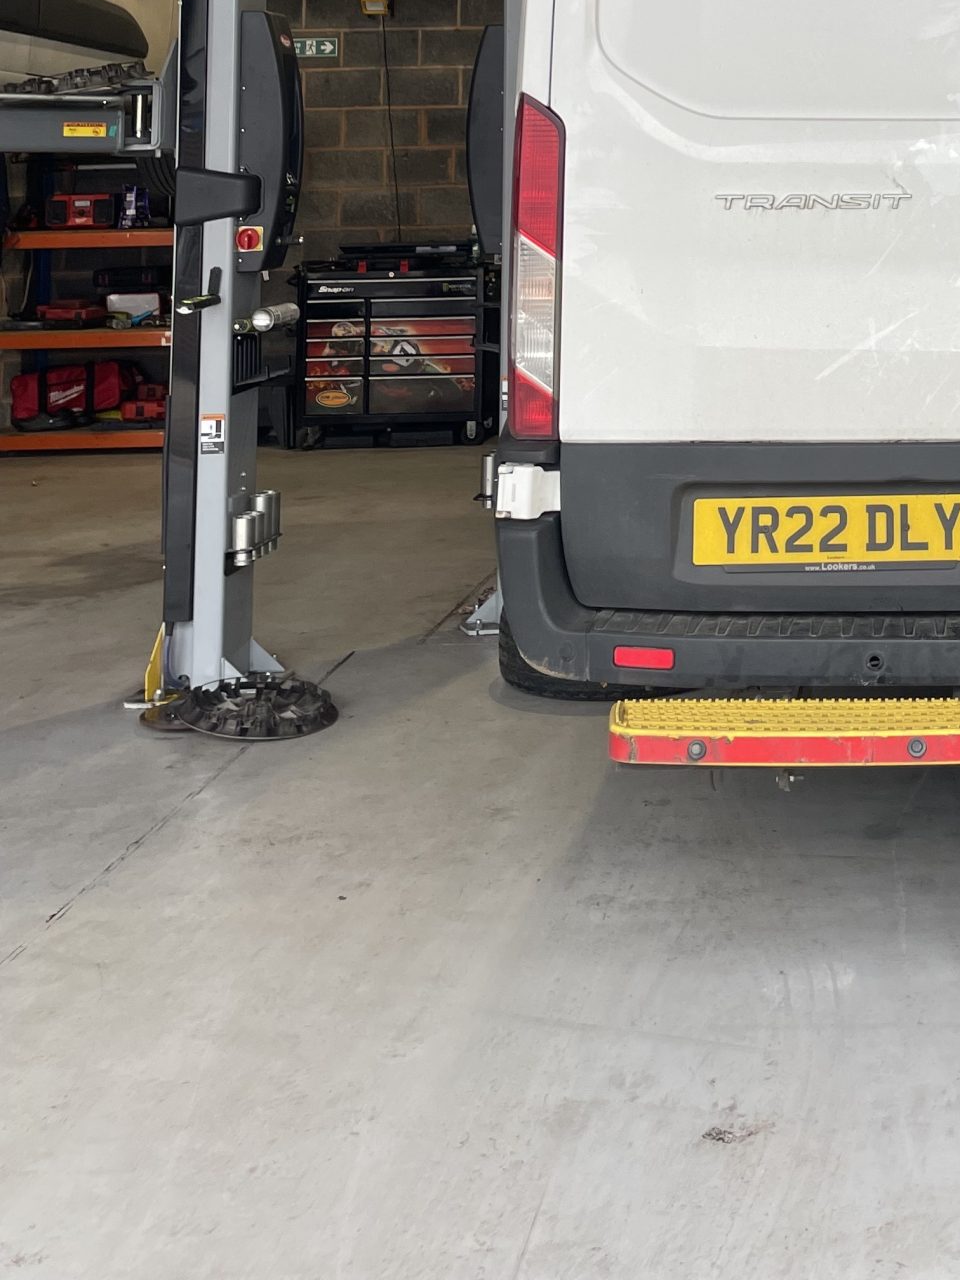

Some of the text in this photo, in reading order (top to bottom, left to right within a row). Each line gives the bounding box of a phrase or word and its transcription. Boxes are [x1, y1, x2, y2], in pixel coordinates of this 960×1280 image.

[715, 193, 913, 210] TRANSIT
[318, 285, 354, 293] Snap-on
[717, 505, 848, 554] YR22
[805, 562, 876, 571] www.Lookers.co.uk
